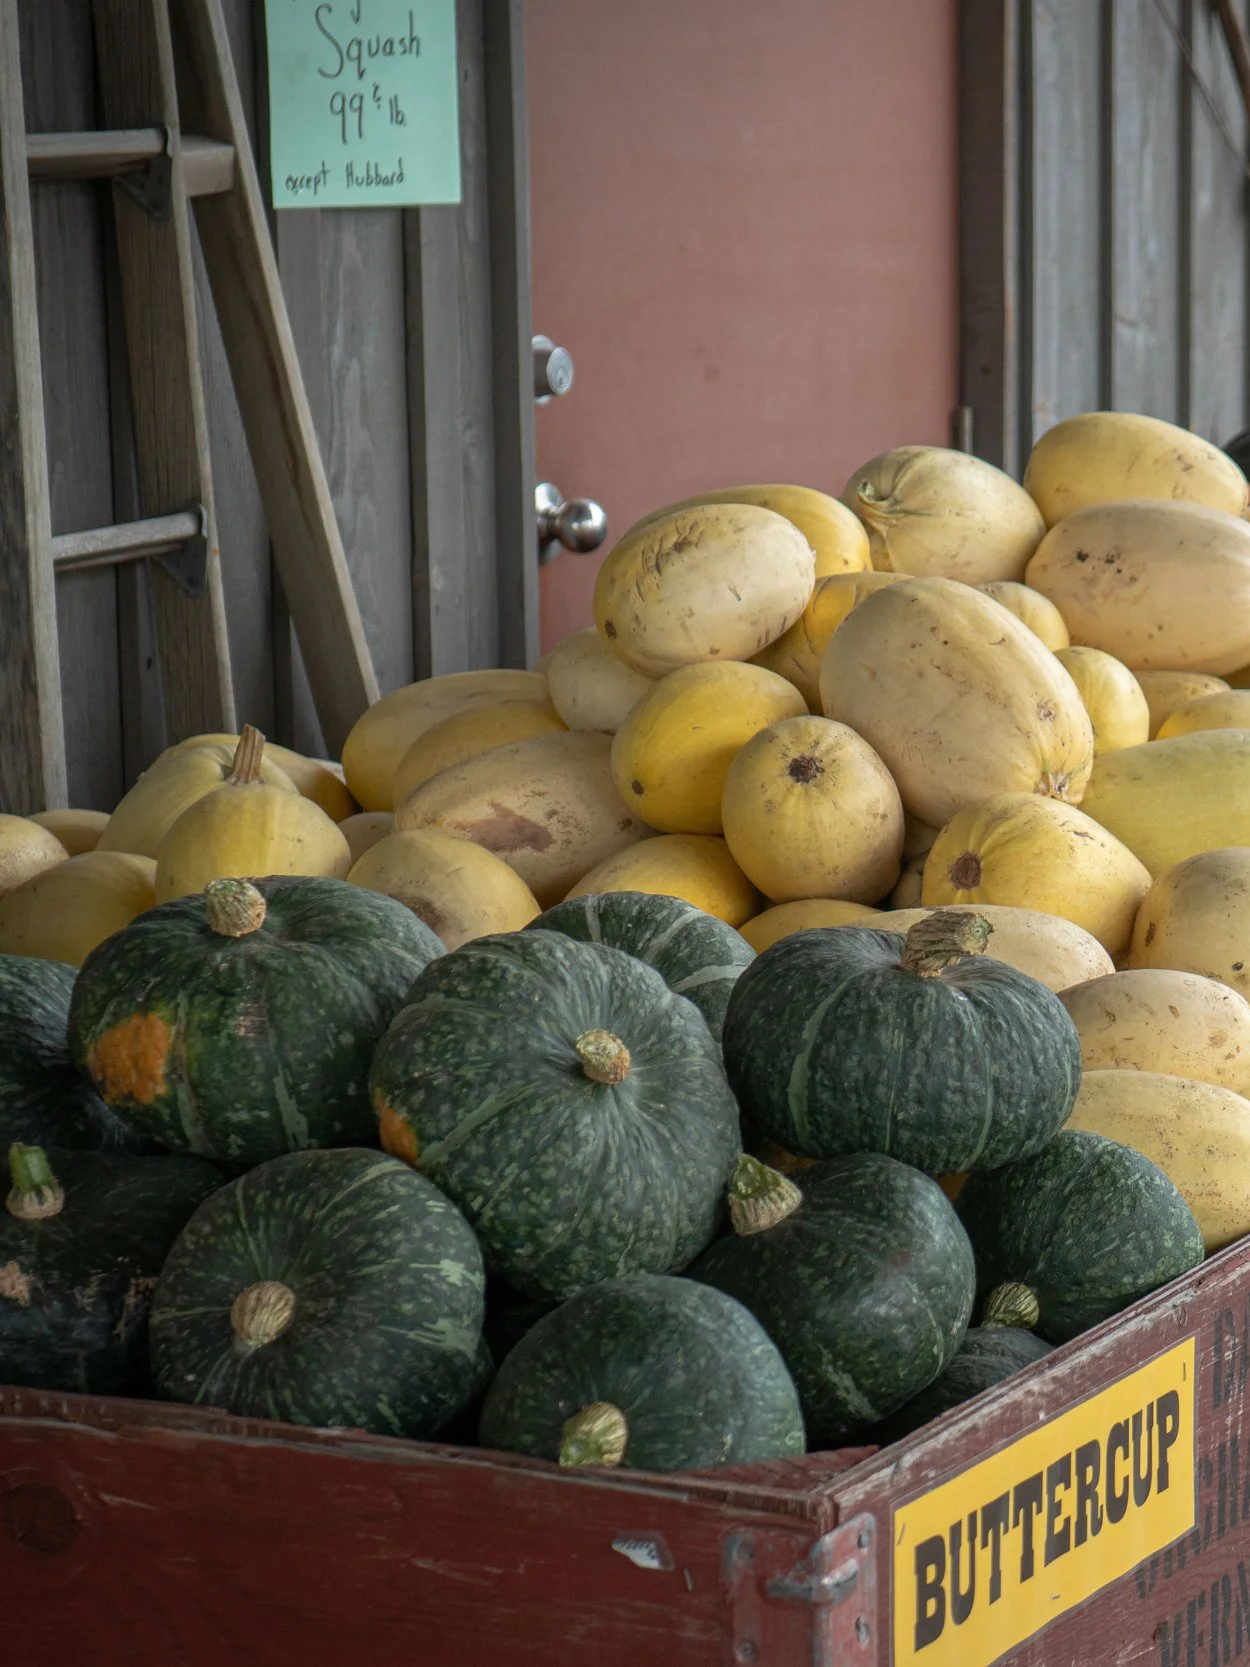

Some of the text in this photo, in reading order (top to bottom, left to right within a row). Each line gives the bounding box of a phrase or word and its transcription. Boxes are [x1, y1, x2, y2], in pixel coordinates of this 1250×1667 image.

[315, 3, 420, 80] Squash
[285, 156, 404, 196] except Hubbard
[914, 1389, 1180, 1653] BUTTERCUP
